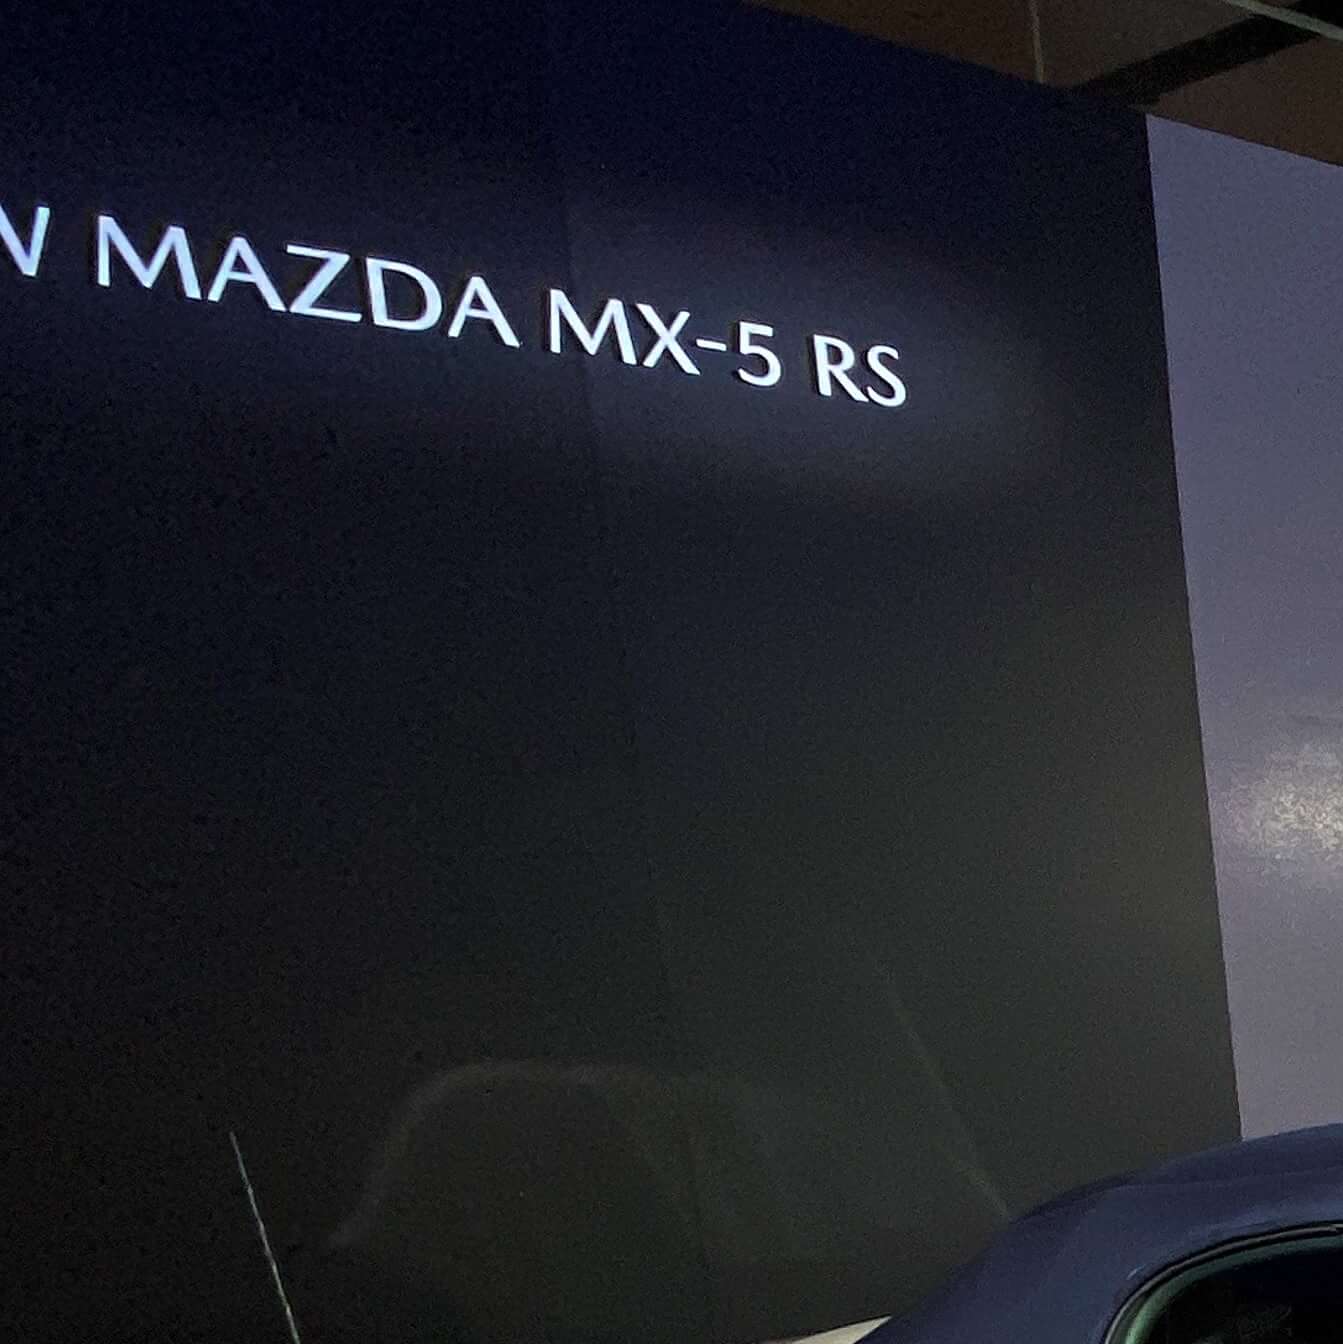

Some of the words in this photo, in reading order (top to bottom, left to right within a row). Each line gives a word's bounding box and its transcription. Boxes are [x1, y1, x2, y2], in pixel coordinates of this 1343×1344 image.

[98, 214, 520, 348] MAZDA
[548, 288, 782, 387] MX-5
[812, 333, 907, 408] RS
